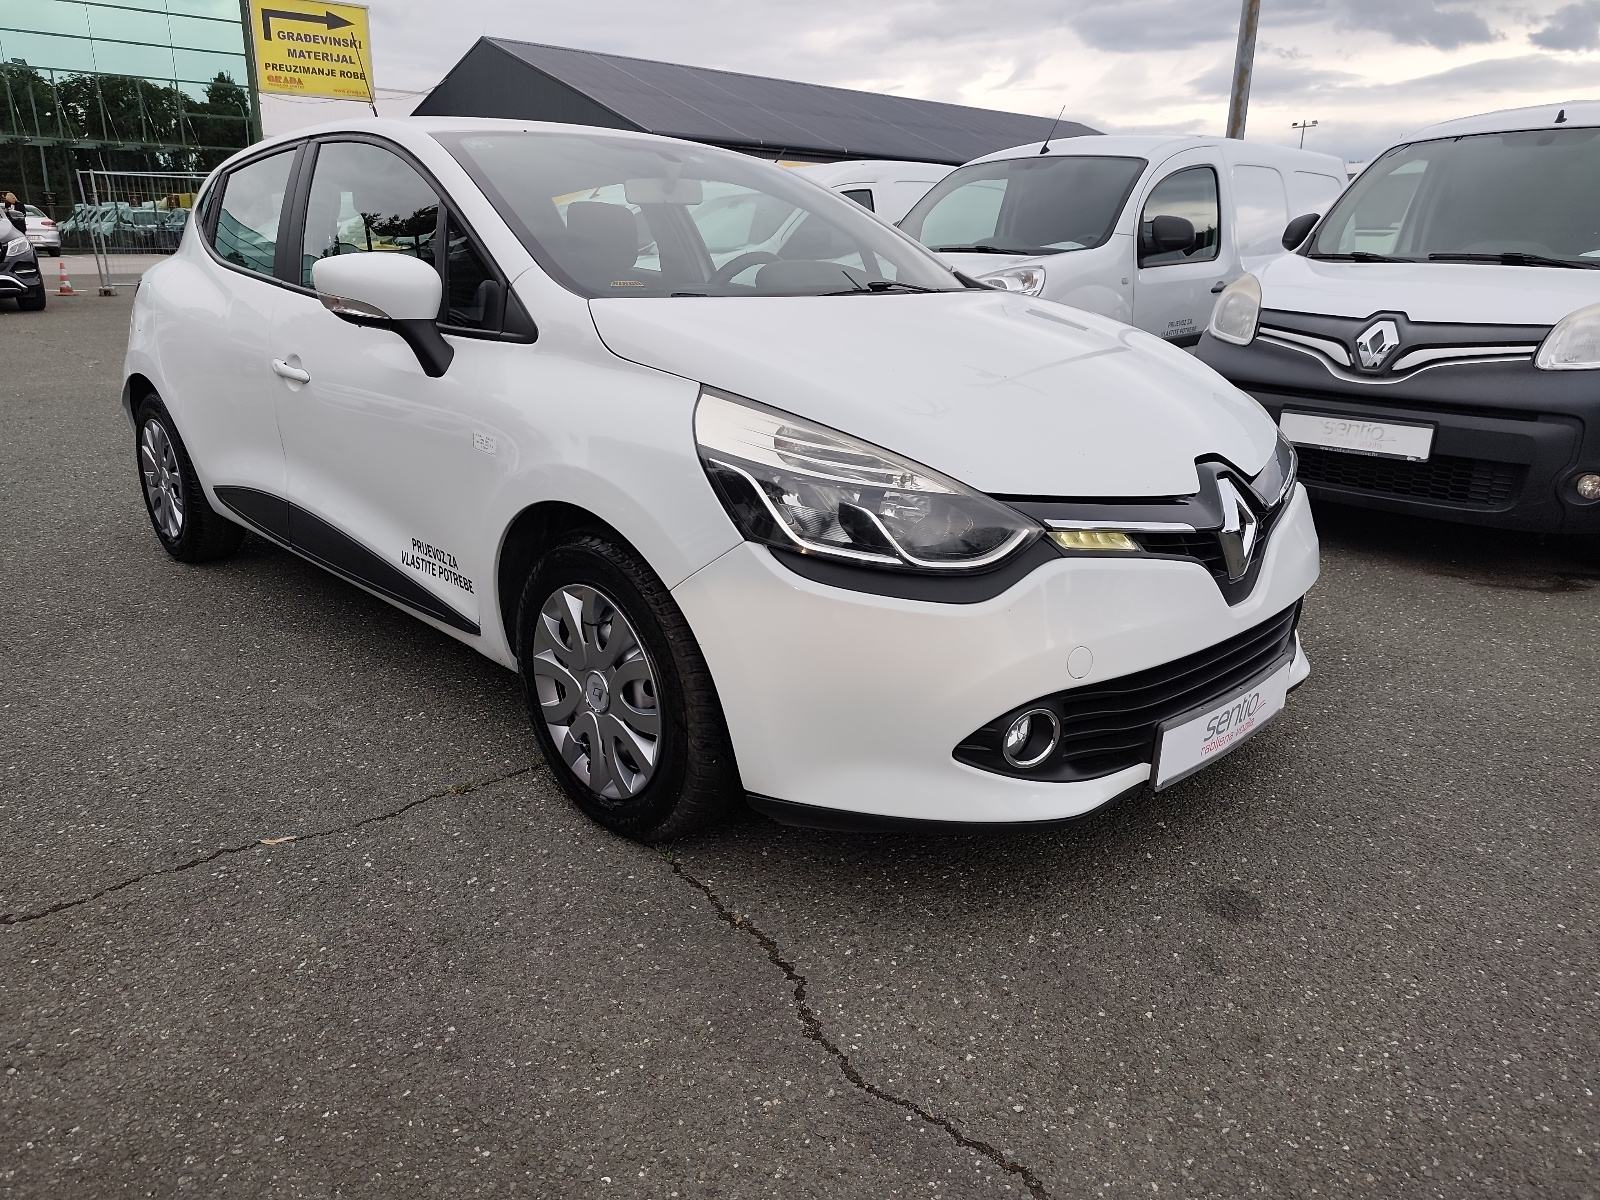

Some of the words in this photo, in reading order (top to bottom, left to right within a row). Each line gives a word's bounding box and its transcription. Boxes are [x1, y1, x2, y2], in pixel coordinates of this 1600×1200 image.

[277, 30, 363, 50] GRAĐEVINSKI
[264, 62, 337, 77] PREUZIMANJE
[287, 48, 356, 65] MATERIJAL
[411, 537, 447, 566] PRIJEVOZ
[446, 553, 459, 571] ZA
[401, 550, 437, 577] VLASTITE
[438, 565, 475, 595] POTREBE
[1203, 692, 1261, 743] sentio
